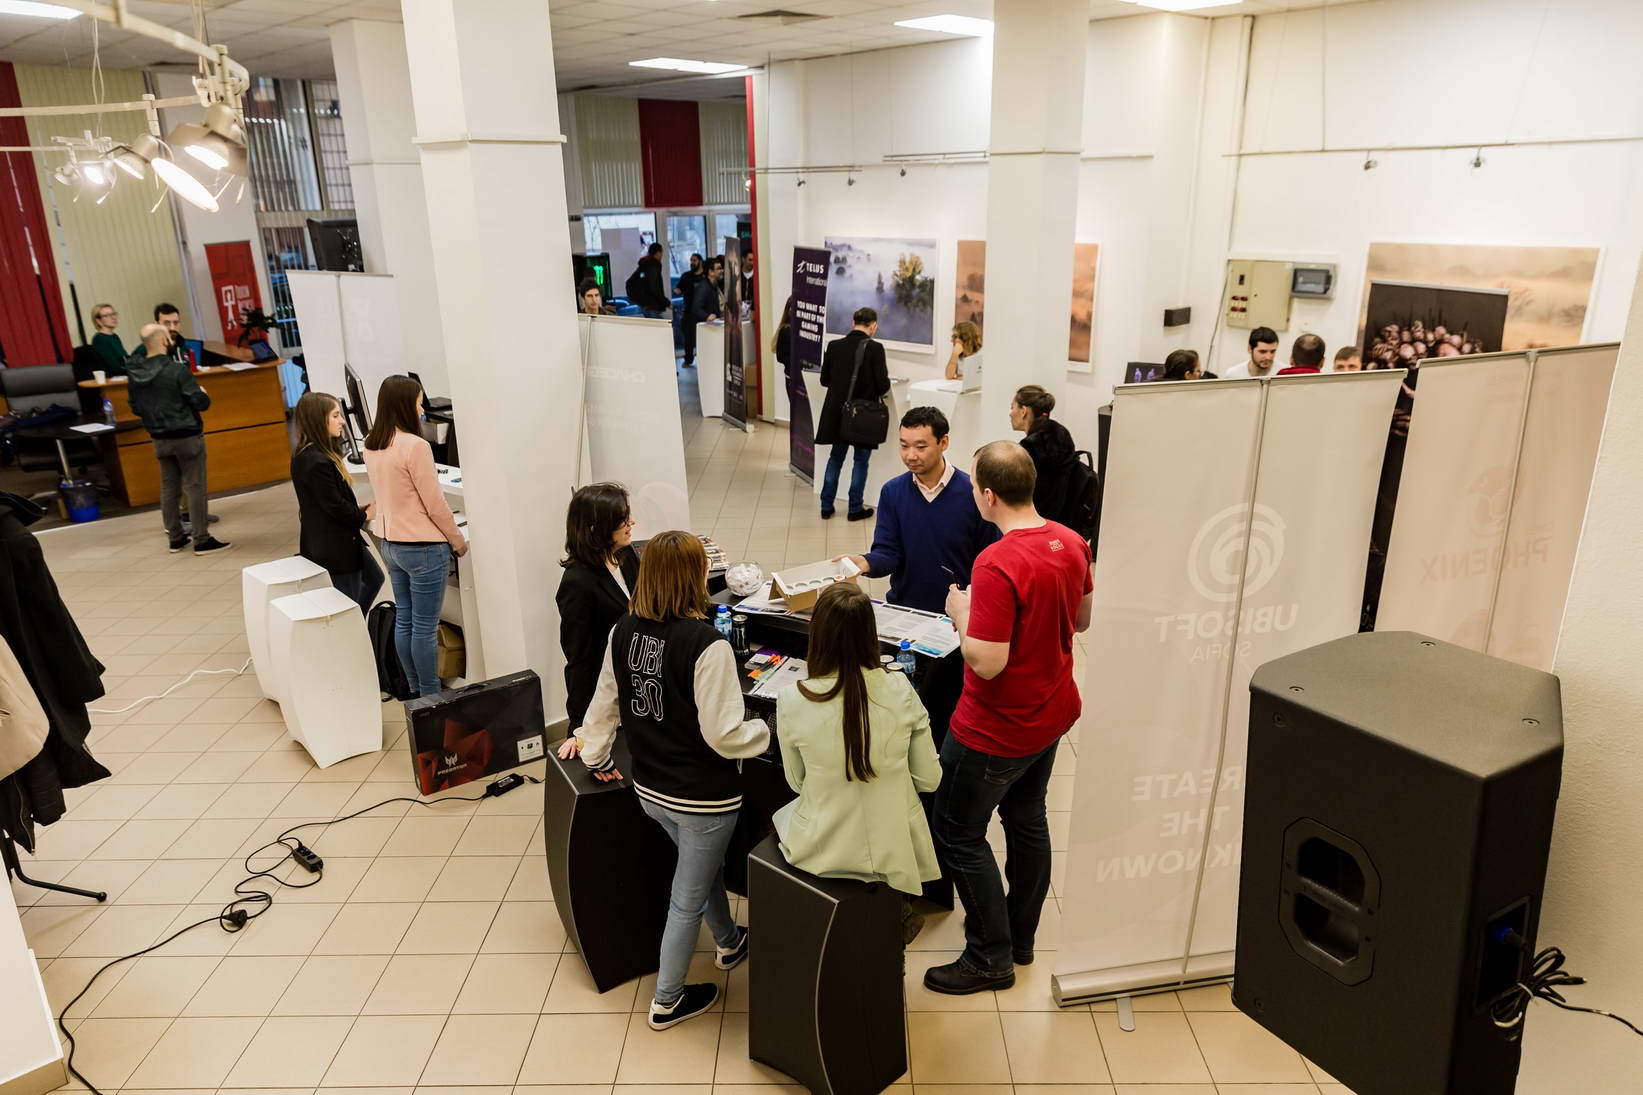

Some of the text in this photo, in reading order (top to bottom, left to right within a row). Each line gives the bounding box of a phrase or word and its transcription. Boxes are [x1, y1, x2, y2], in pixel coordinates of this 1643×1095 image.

[806, 263, 824, 274] TELUS
[796, 300, 805, 309] YOU
[806, 302, 818, 312] WANT
[801, 311, 811, 320] PART
[801, 321, 818, 332] GAMING
[628, 632, 665, 677] UBI
[631, 673, 663, 721] 30
